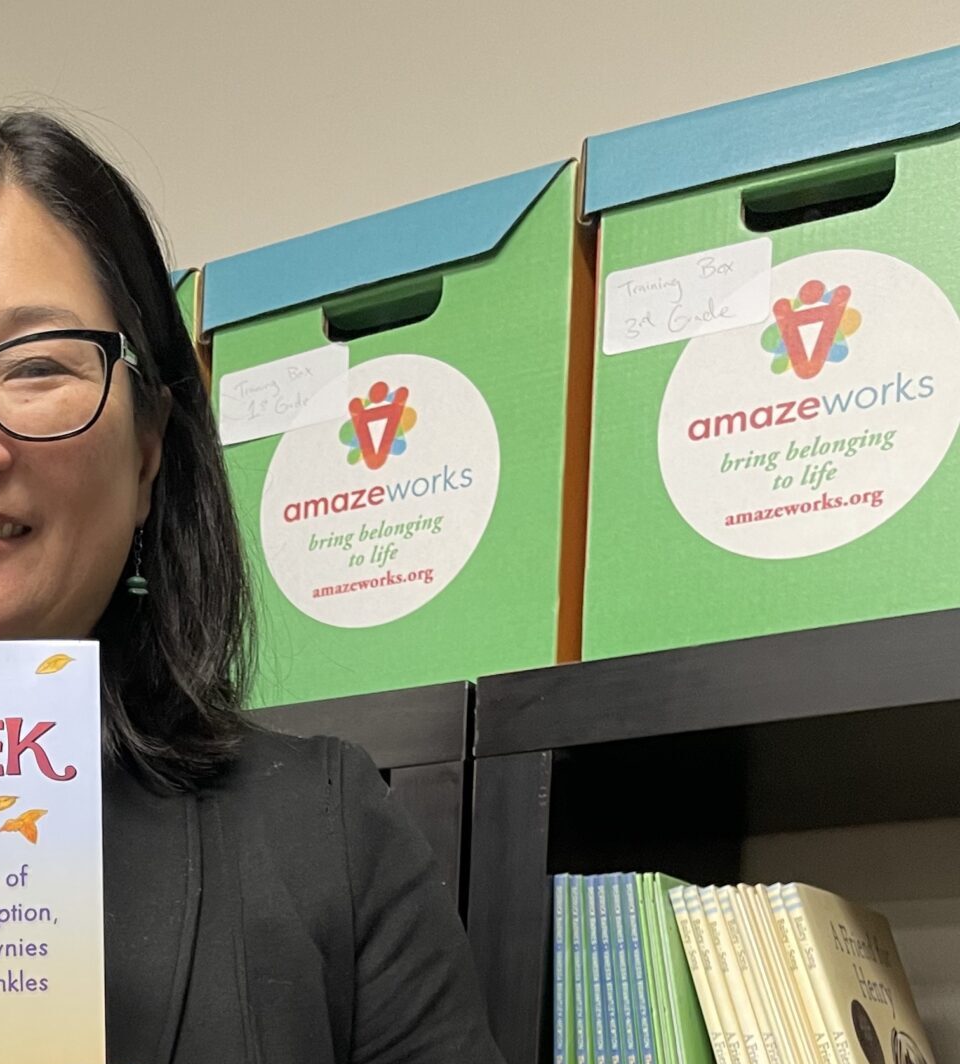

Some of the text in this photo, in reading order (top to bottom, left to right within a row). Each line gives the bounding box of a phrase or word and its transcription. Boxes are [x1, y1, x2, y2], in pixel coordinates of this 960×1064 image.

[617, 256, 735, 304] Training Box
[625, 311, 656, 339] 3rd
[688, 372, 935, 441] amazeworks
[720, 429, 897, 473] bring belonging
[283, 465, 473, 522] amazeworks
[772, 461, 838, 491] to life
[724, 490, 884, 526] amazeworks.org
[308, 515, 444, 551] bring belonging
[348, 542, 399, 568] to life
[312, 568, 434, 598] amazeworks.org
[6, 864, 29, 887] of
